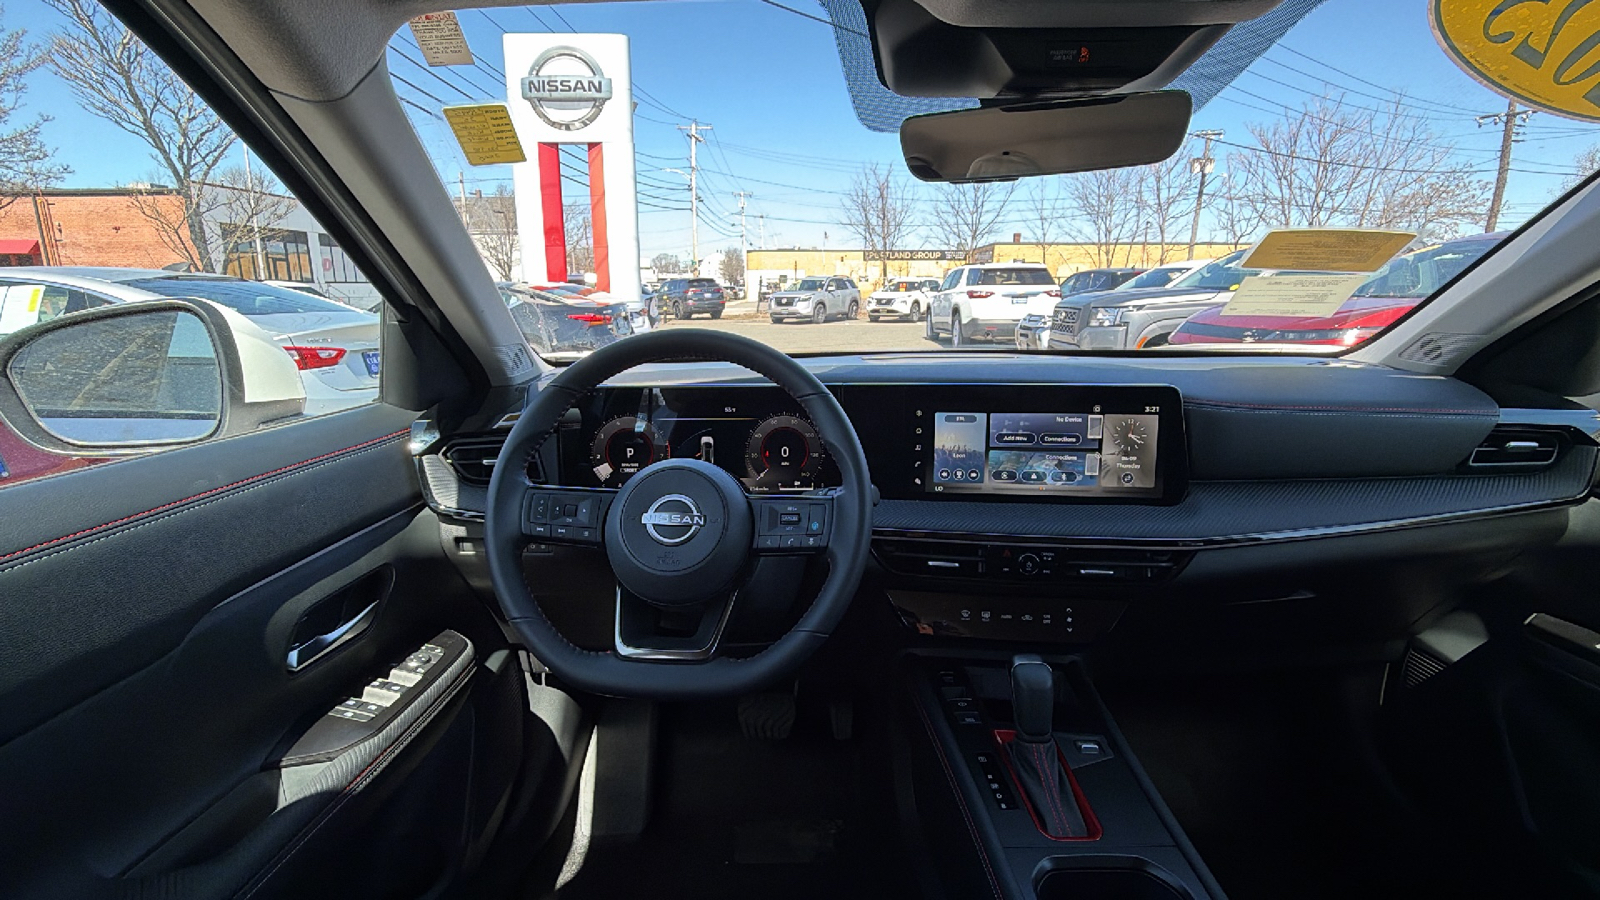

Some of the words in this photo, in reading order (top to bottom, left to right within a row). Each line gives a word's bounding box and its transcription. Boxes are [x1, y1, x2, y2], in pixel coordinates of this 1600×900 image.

[528, 79, 602, 93] NISSAN
[912, 251, 942, 259] GROUP
[626, 447, 634, 459] P
[781, 446, 789, 458] 0
[1116, 462, 1141, 470] Thursday
[645, 514, 704, 525] NISSAN
